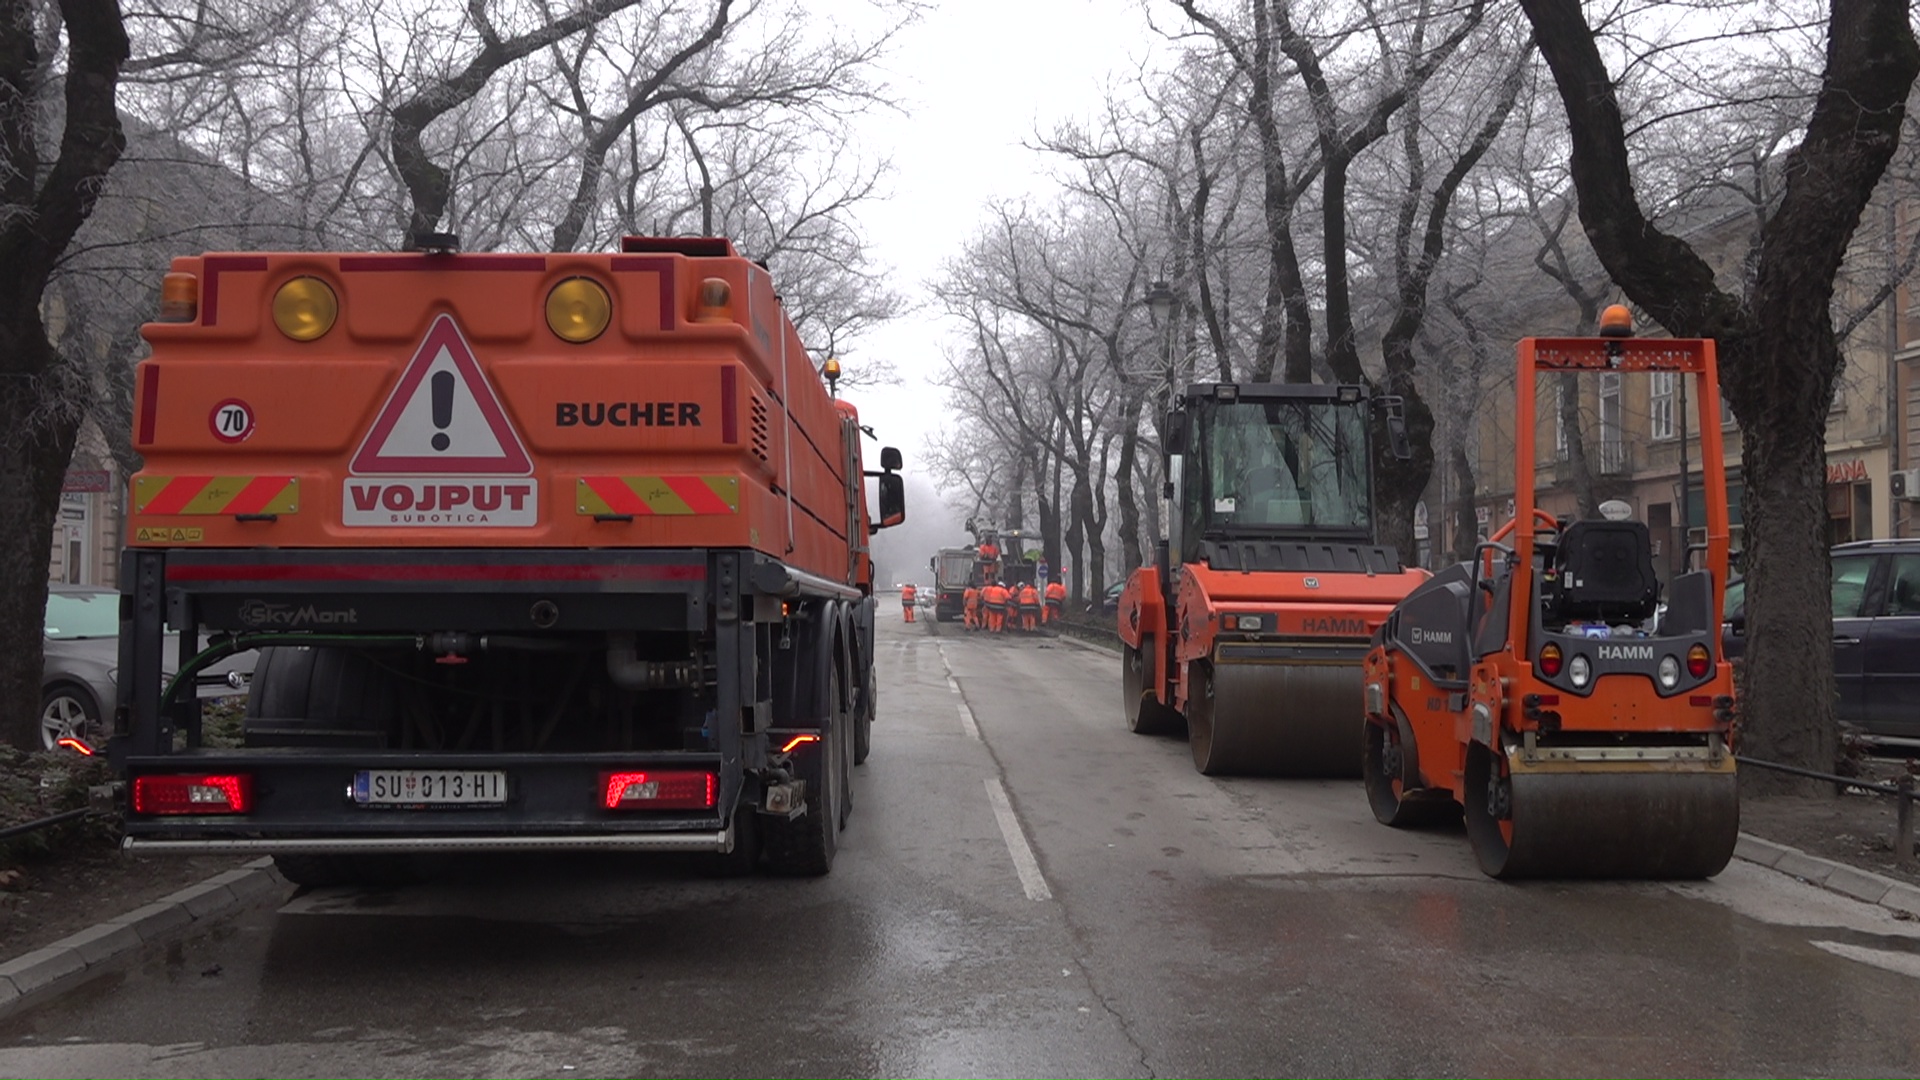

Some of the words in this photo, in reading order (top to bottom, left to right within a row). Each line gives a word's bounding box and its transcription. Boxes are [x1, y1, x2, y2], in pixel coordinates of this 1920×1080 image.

[222, 409, 244, 432] 70
[556, 402, 702, 427] BUCHER
[350, 485, 531, 511] VOJPUT
[390, 514, 489, 523] SUBOTICA
[1303, 618, 1365, 633] HAMM
[1423, 631, 1452, 644] HAMM
[1598, 645, 1653, 660] HAMM
[1427, 697, 1441, 711] HD
[375, 775, 401, 798] SU
